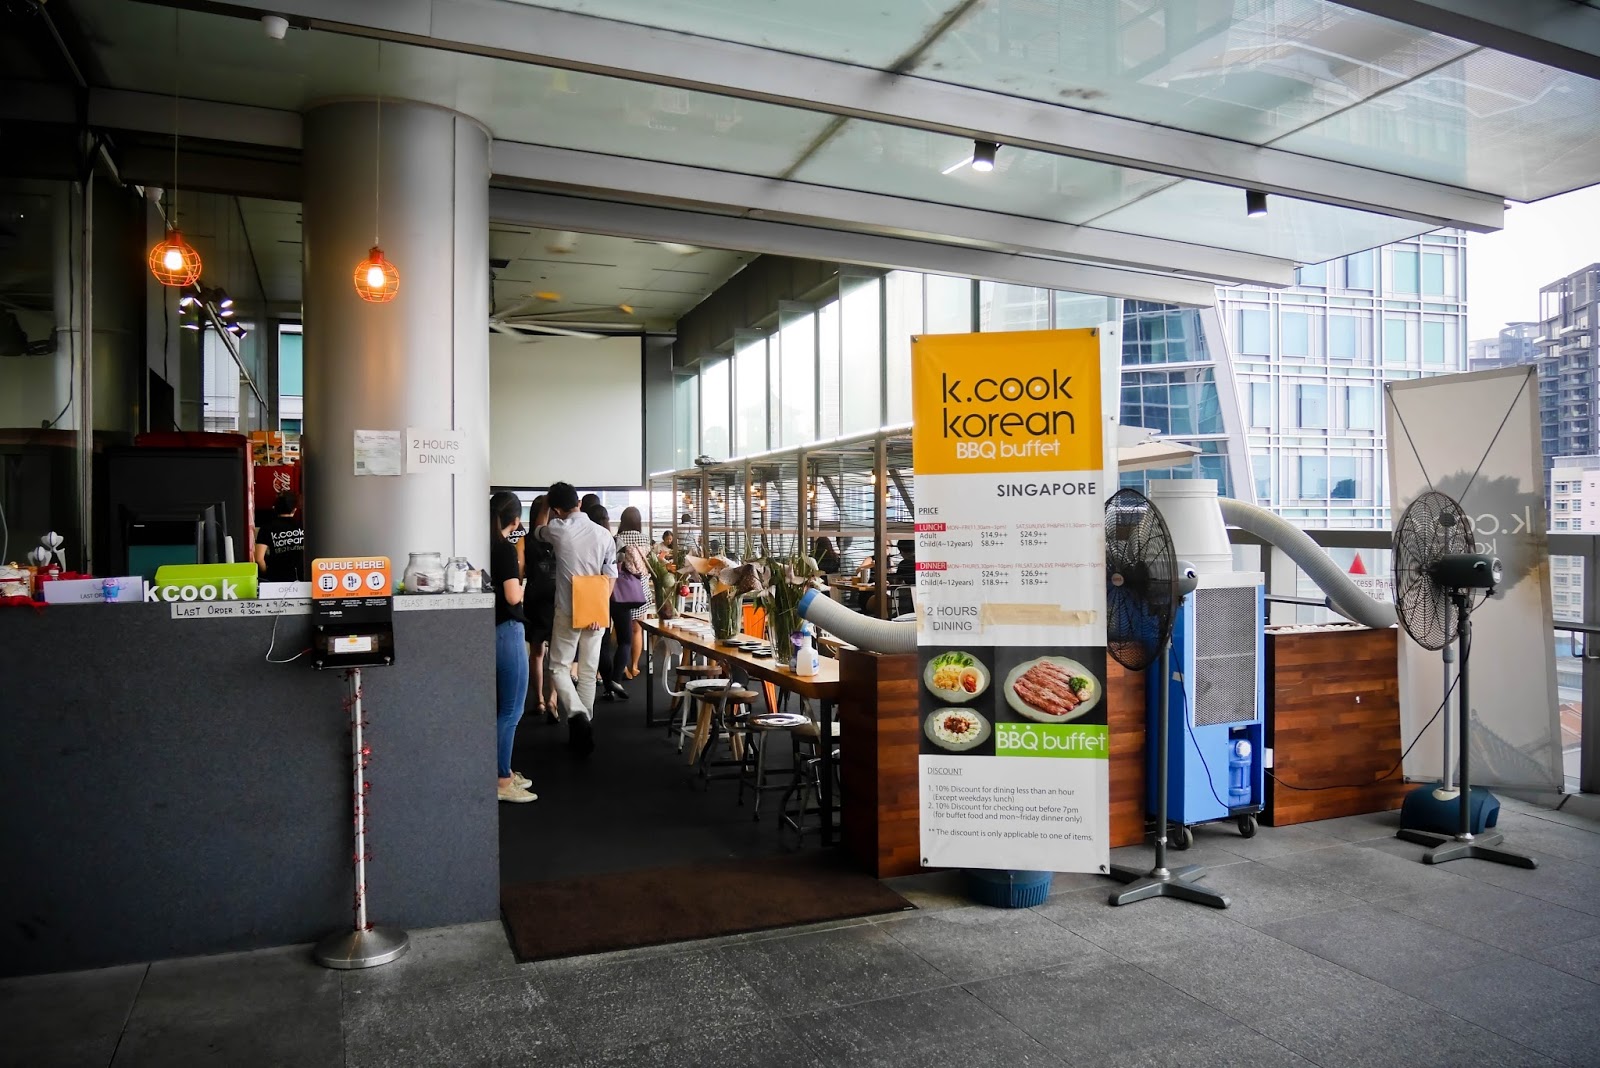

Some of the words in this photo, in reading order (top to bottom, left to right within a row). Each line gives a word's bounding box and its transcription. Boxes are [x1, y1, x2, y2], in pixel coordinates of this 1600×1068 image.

[942, 368, 1073, 404] k.cook
[943, 407, 1075, 438] korean
[413, 440, 420, 449] 2
[423, 440, 459, 450] HOURS
[956, 440, 996, 459] BBQ
[1000, 439, 1061, 457] buffet
[419, 454, 455, 464] DINING
[997, 482, 1096, 497] SINGAPORE
[918, 507, 938, 515] PRICE
[980, 531, 1008, 539] $14.9++
[1020, 530, 1047, 538] $24.9++
[981, 539, 1004, 547] $8.9++
[1020, 538, 1048, 546] $18.9++
[318, 561, 354, 570] QUEUE
[355, 560, 385, 569] HERE!
[920, 562, 946, 570] DINNER
[981, 570, 1009, 578] $24.9++
[1021, 578, 1048, 586] $18.9++
[927, 606, 934, 616] 2
[936, 606, 978, 616] HOURS
[932, 621, 973, 631] DINING
[997, 730, 1038, 750] BBQ
[1043, 731, 1106, 750] buffet
[927, 767, 963, 776] DISCOUNT
[951, 785, 980, 793] Discount
[993, 786, 1015, 795] dining
[1030, 787, 1046, 795] than
[932, 793, 958, 802] (Except
[958, 795, 992, 803] weekdays
[993, 795, 1015, 803] lunch)
[935, 802, 950, 810] 10%
[993, 804, 1024, 813] checking
[1038, 805, 1061, 813] before
[1062, 806, 1079, 814] 7pm
[932, 811, 945, 819] (for
[984, 812, 998, 820] and
[1040, 814, 1063, 822] dinner
[1064, 815, 1083, 824] only)
[936, 828, 949, 836] The
[950, 829, 980, 837] discount
[987, 830, 1002, 838] only
[1003, 831, 1039, 840] applicable
